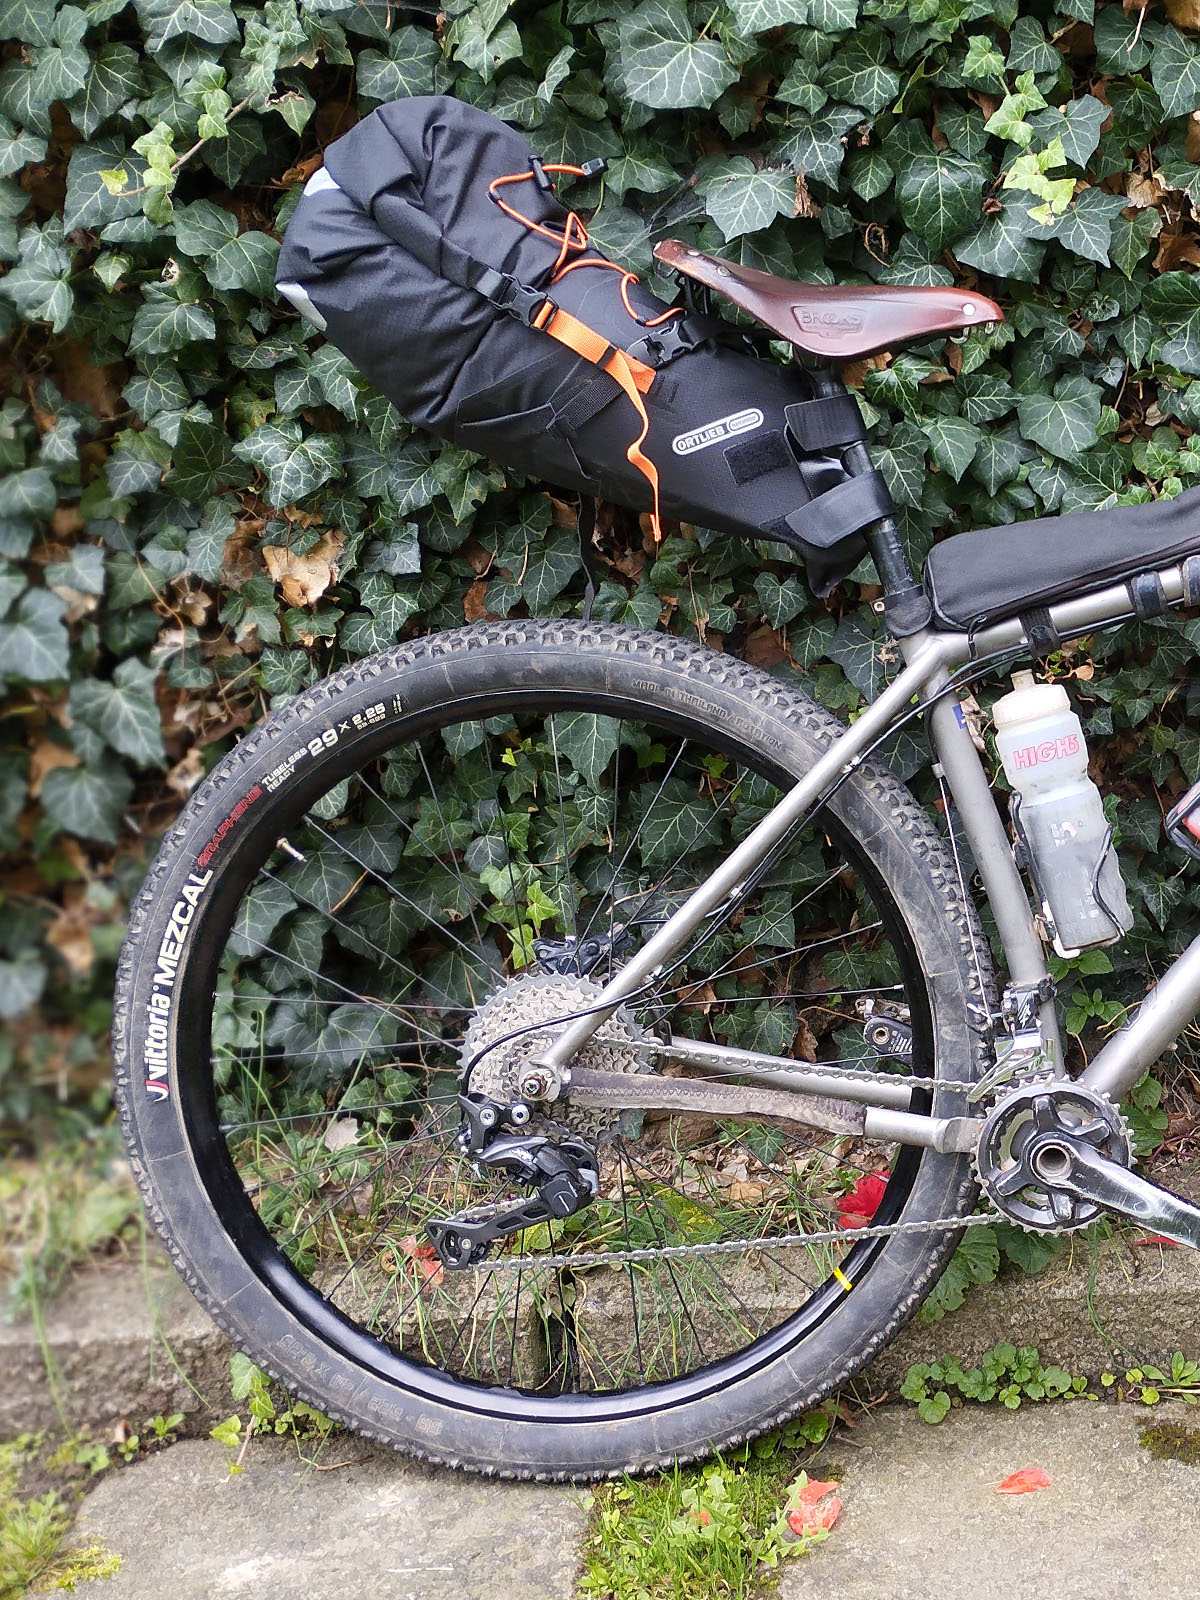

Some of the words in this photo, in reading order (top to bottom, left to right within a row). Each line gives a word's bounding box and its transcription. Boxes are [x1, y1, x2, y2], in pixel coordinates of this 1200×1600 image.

[801, 310, 862, 326] BROOKS
[677, 426, 726, 452] ORTLIEB
[351, 702, 386, 726] 2.25
[307, 728, 340, 759] 29
[261, 746, 309, 786] TUBELESS
[266, 767, 296, 793] READY
[197, 785, 264, 868] GRAPHENE
[153, 869, 214, 985] MEZCAL
[144, 993, 171, 1082] vittoria
